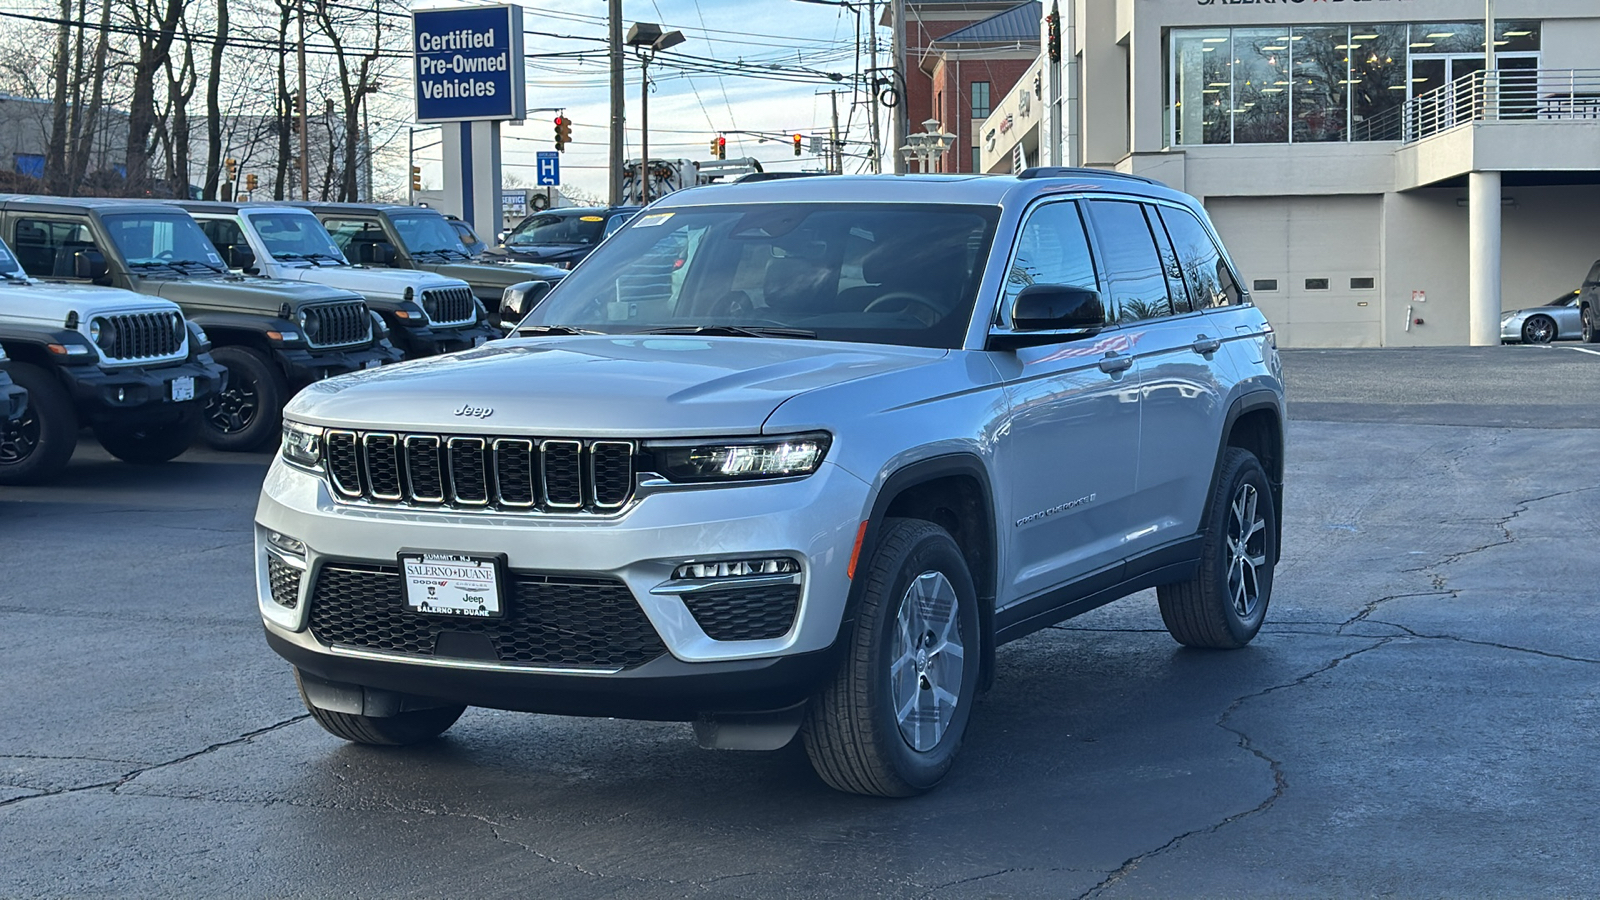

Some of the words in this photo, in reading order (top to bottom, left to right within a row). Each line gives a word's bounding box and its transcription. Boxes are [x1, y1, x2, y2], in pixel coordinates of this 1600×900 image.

[420, 28, 494, 51] Certified
[421, 52, 507, 75] Pre-Owned
[421, 78, 495, 99] Vehicles
[541, 159, 555, 176] H
[502, 196, 525, 204] SERVICE
[453, 403, 494, 420] Jeep
[407, 565, 453, 577] SALERNO
[457, 568, 493, 580] DUANE
[462, 594, 484, 604] Jeep
[417, 606, 453, 615] SALERNO
[464, 608, 490, 617] DUANE
